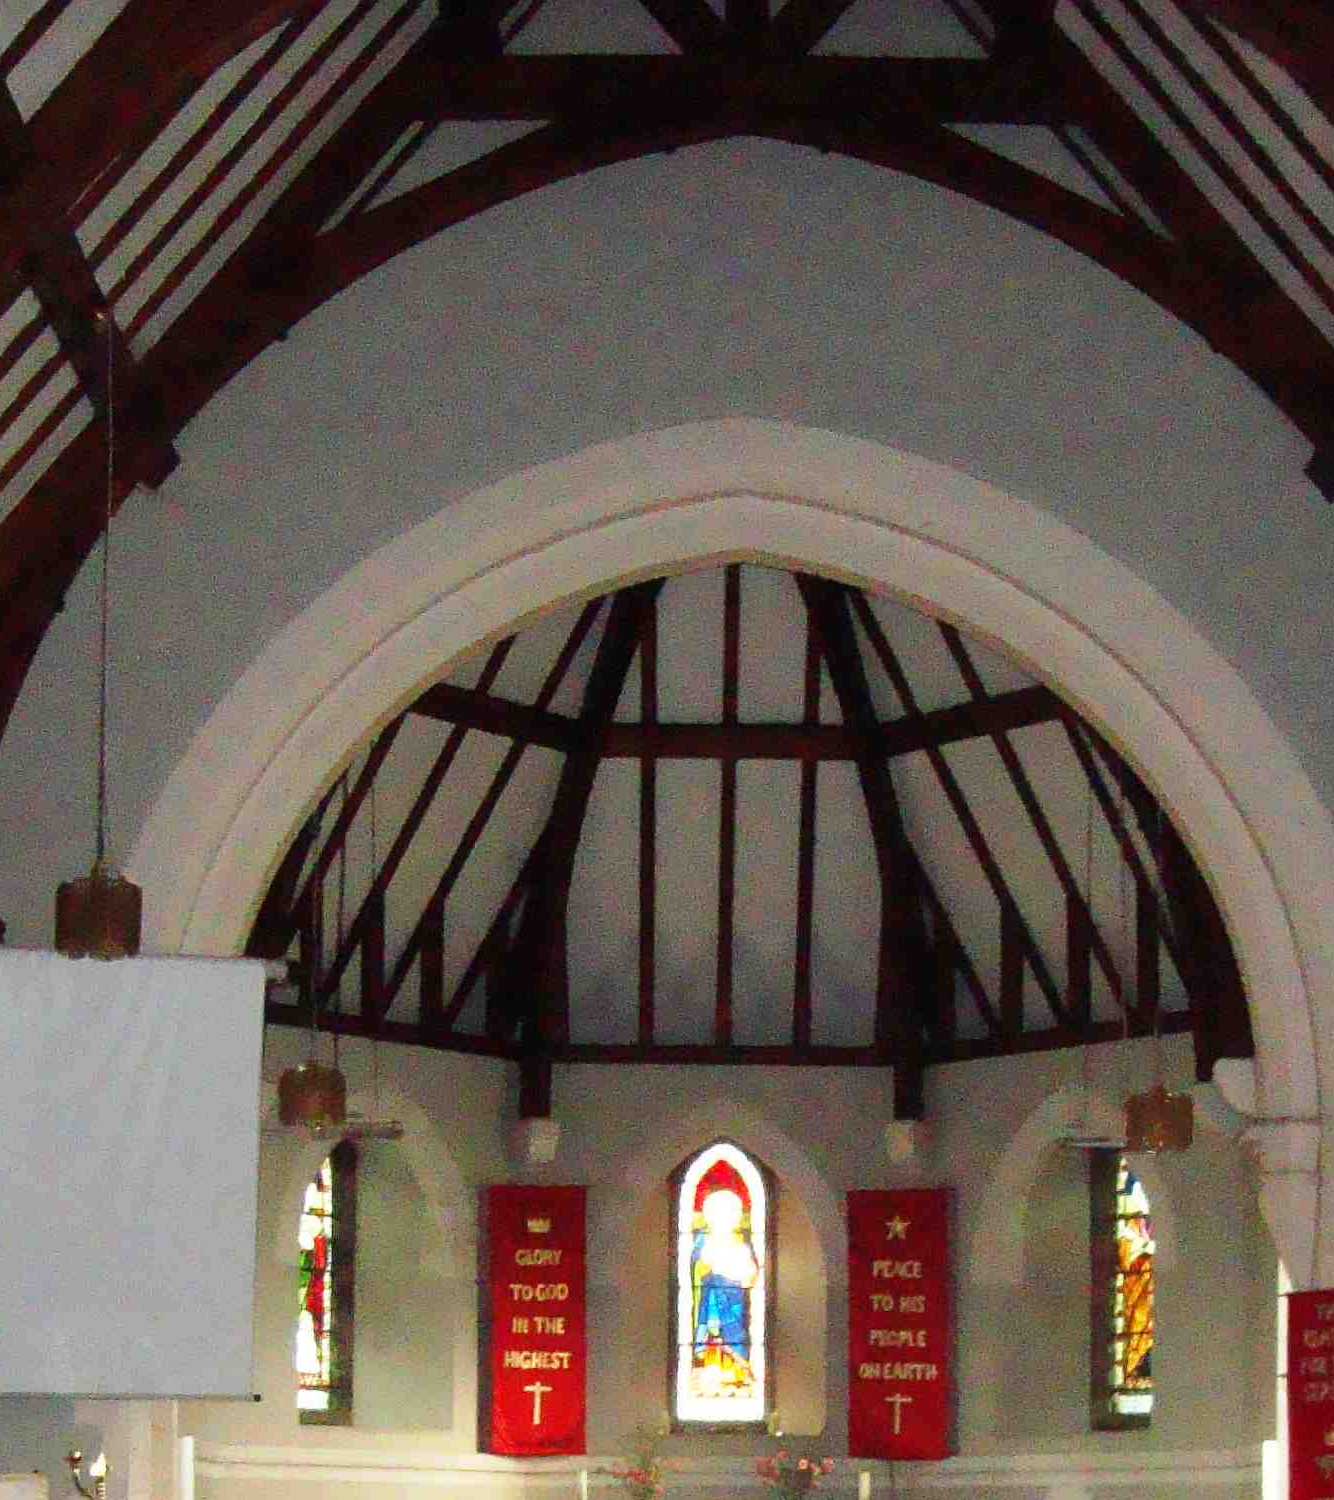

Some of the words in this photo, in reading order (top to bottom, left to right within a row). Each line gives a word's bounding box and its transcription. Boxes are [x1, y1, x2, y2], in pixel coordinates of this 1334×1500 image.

[514, 1249, 562, 1266] GLORY
[872, 1260, 923, 1280] PEACE
[510, 1284, 533, 1301] TO
[535, 1284, 569, 1301] GOD
[870, 1295, 893, 1313] TO
[899, 1295, 925, 1313] HIS
[512, 1317, 529, 1335] IN
[534, 1317, 565, 1335] THE
[870, 1329, 928, 1349] PEOPLE
[505, 1351, 571, 1369] HIGHEST
[859, 1363, 880, 1379] ON
[882, 1362, 938, 1381] EARTH
